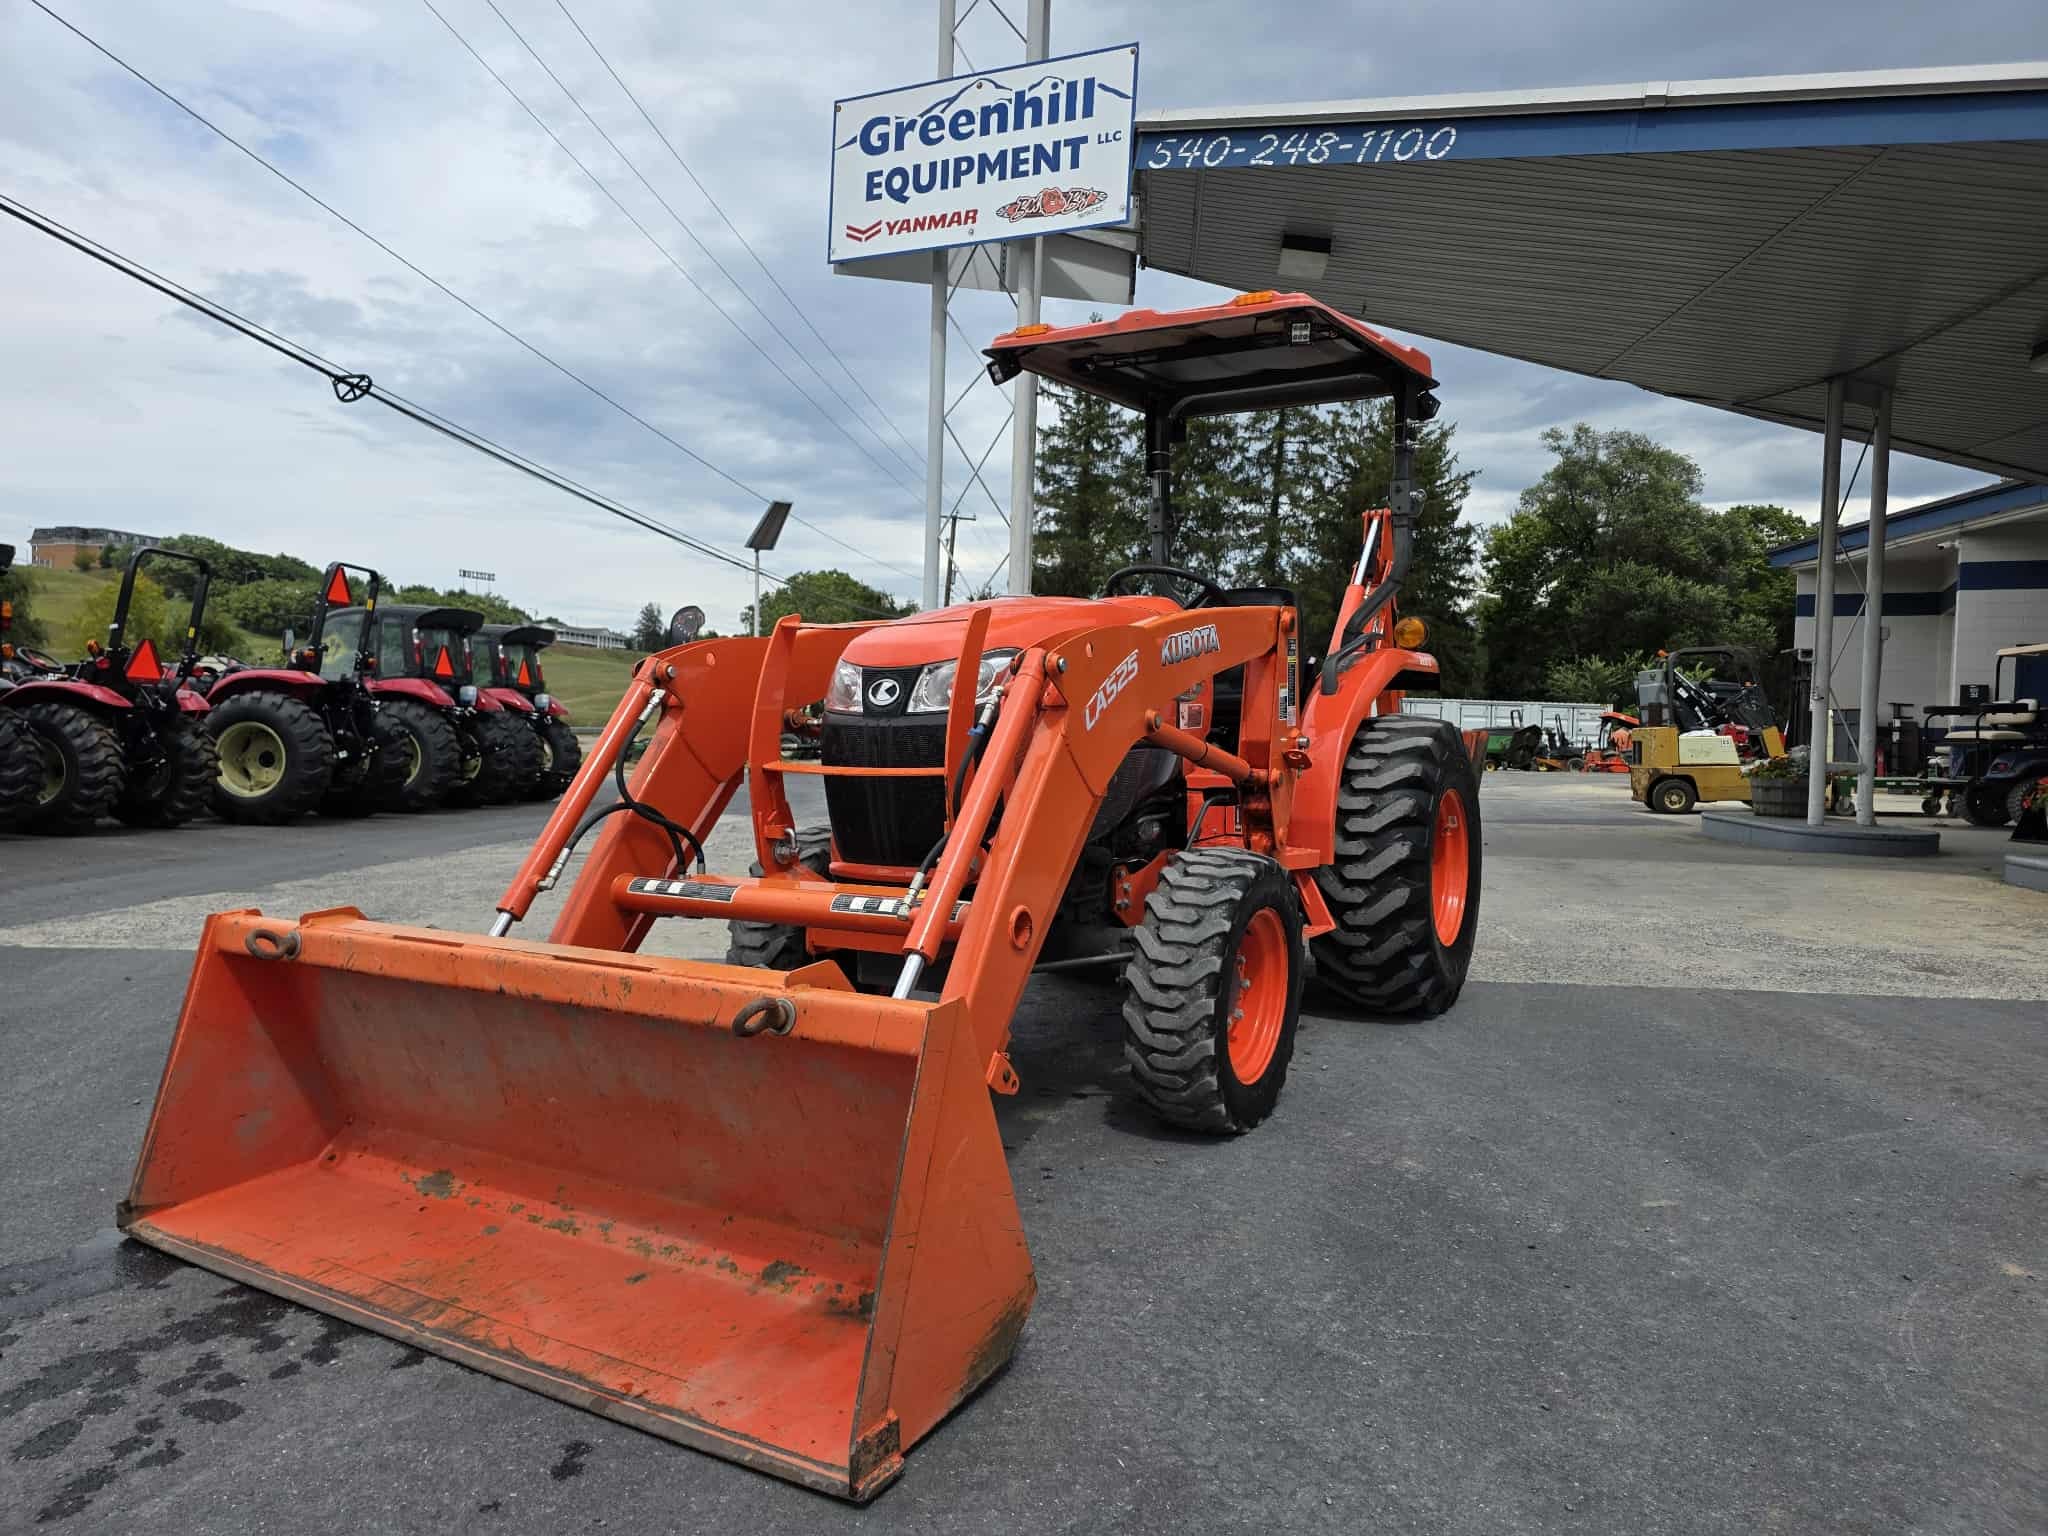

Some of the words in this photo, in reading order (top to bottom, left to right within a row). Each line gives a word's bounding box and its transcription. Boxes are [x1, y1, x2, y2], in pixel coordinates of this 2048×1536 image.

[859, 77, 1096, 157] Greenhill
[865, 135, 1089, 204] EQUIPMENT
[1097, 130, 1122, 145] LLC
[1148, 126, 1457, 169] 540-248-1100
[885, 208, 978, 236] YANMAR
[1161, 624, 1220, 667] KUBOTA
